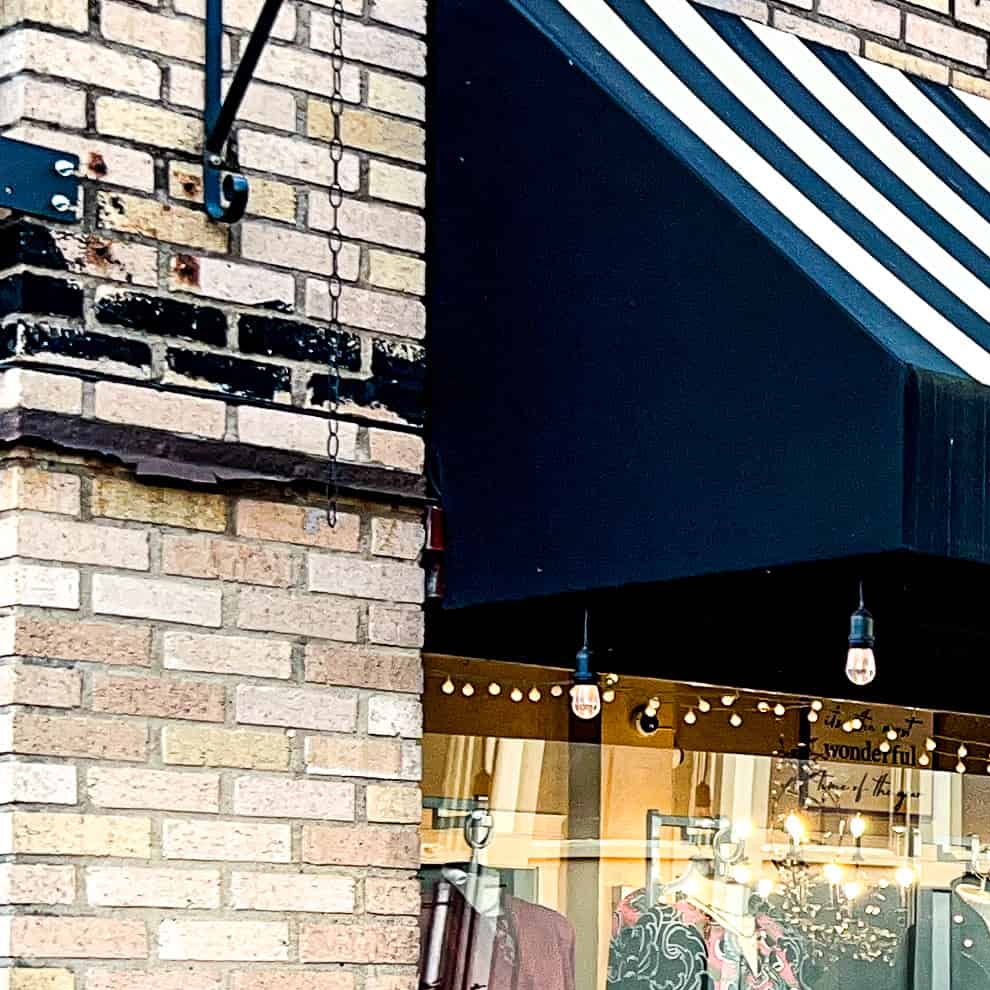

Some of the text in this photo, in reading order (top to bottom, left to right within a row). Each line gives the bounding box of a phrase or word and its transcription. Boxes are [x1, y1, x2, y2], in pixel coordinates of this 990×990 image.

[824, 739, 916, 767] wonderful
[811, 769, 849, 792] time
[853, 772, 869, 802] of
[872, 772, 891, 798] the
